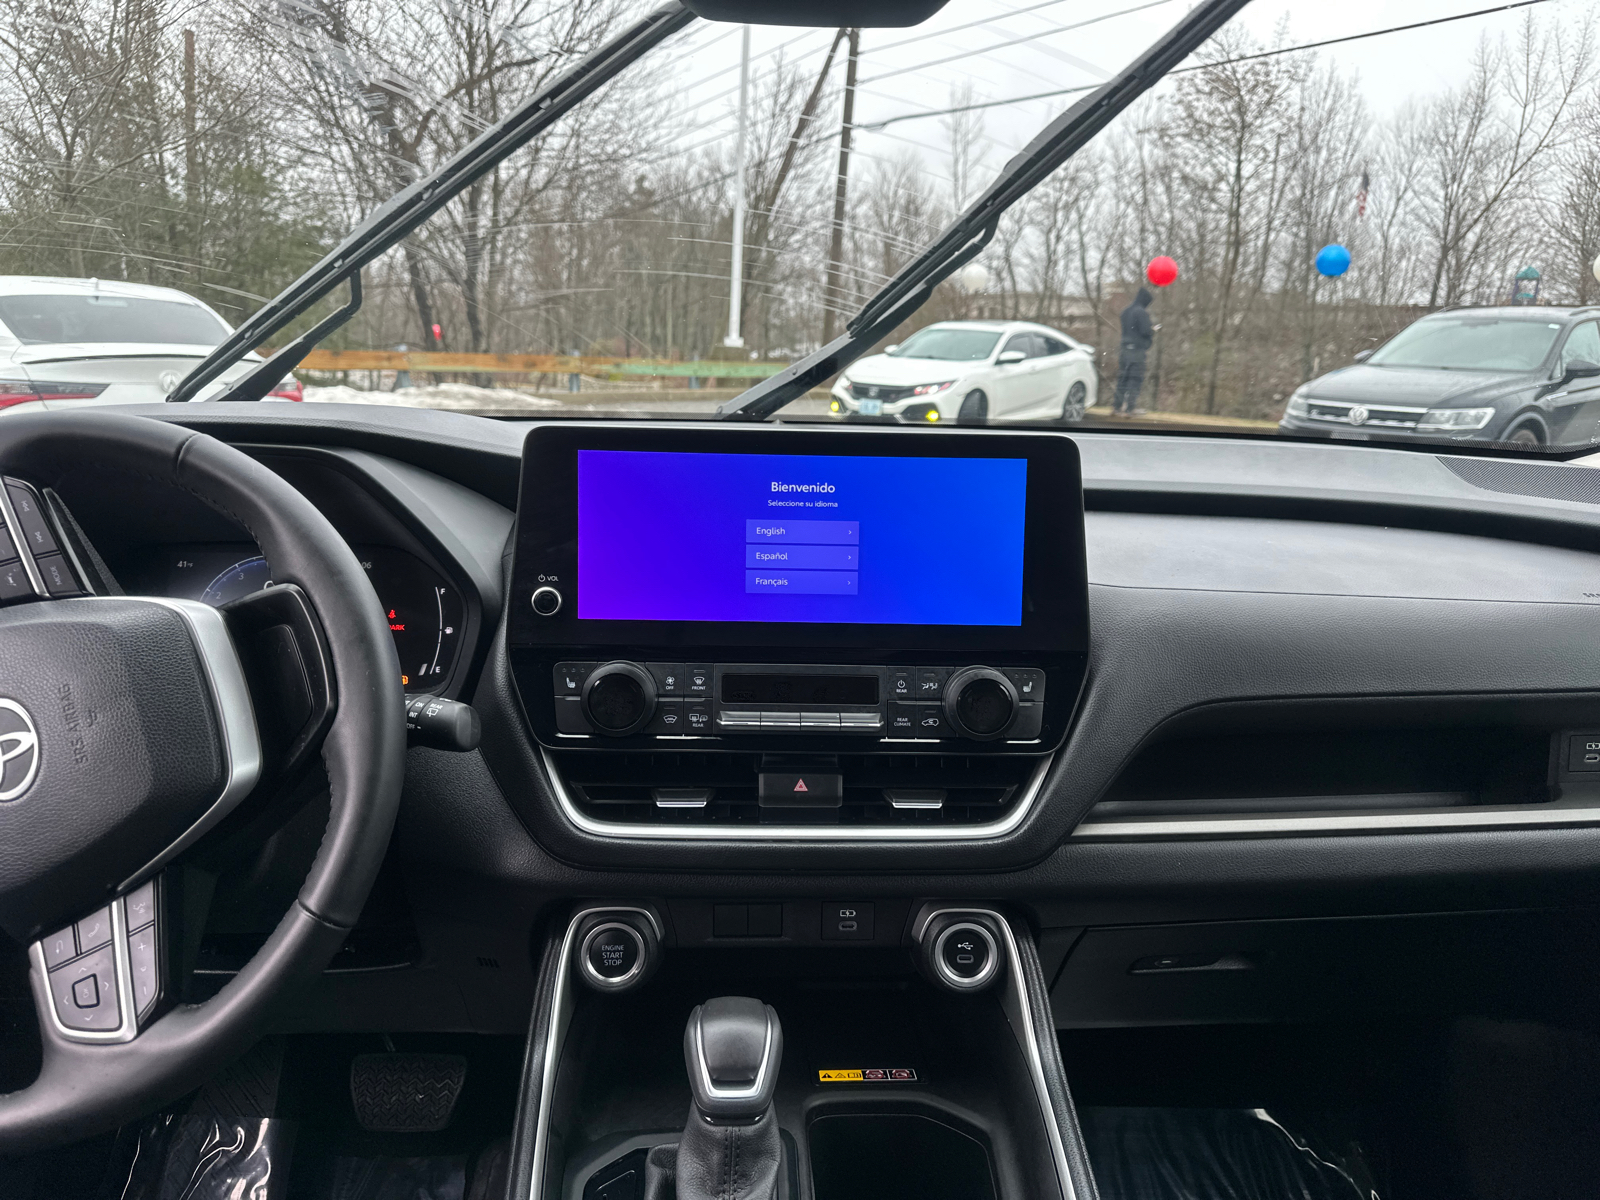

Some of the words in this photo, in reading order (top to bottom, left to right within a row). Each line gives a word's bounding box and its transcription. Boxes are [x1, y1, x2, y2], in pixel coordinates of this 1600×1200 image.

[771, 481, 836, 493] Bienvenido
[767, 499, 804, 507] Seleccione
[814, 500, 839, 508] idioma
[756, 527, 786, 537] English
[755, 551, 788, 561] Español
[49, 565, 63, 586] MODE
[755, 577, 789, 587] Français
[215, 592, 222, 600] 2
[440, 587, 446, 595] F
[435, 665, 441, 673] E
[59, 683, 81, 732] AIRBAG
[408, 711, 418, 719] INT
[71, 737, 89, 764] SRS
[602, 951, 624, 959] START
